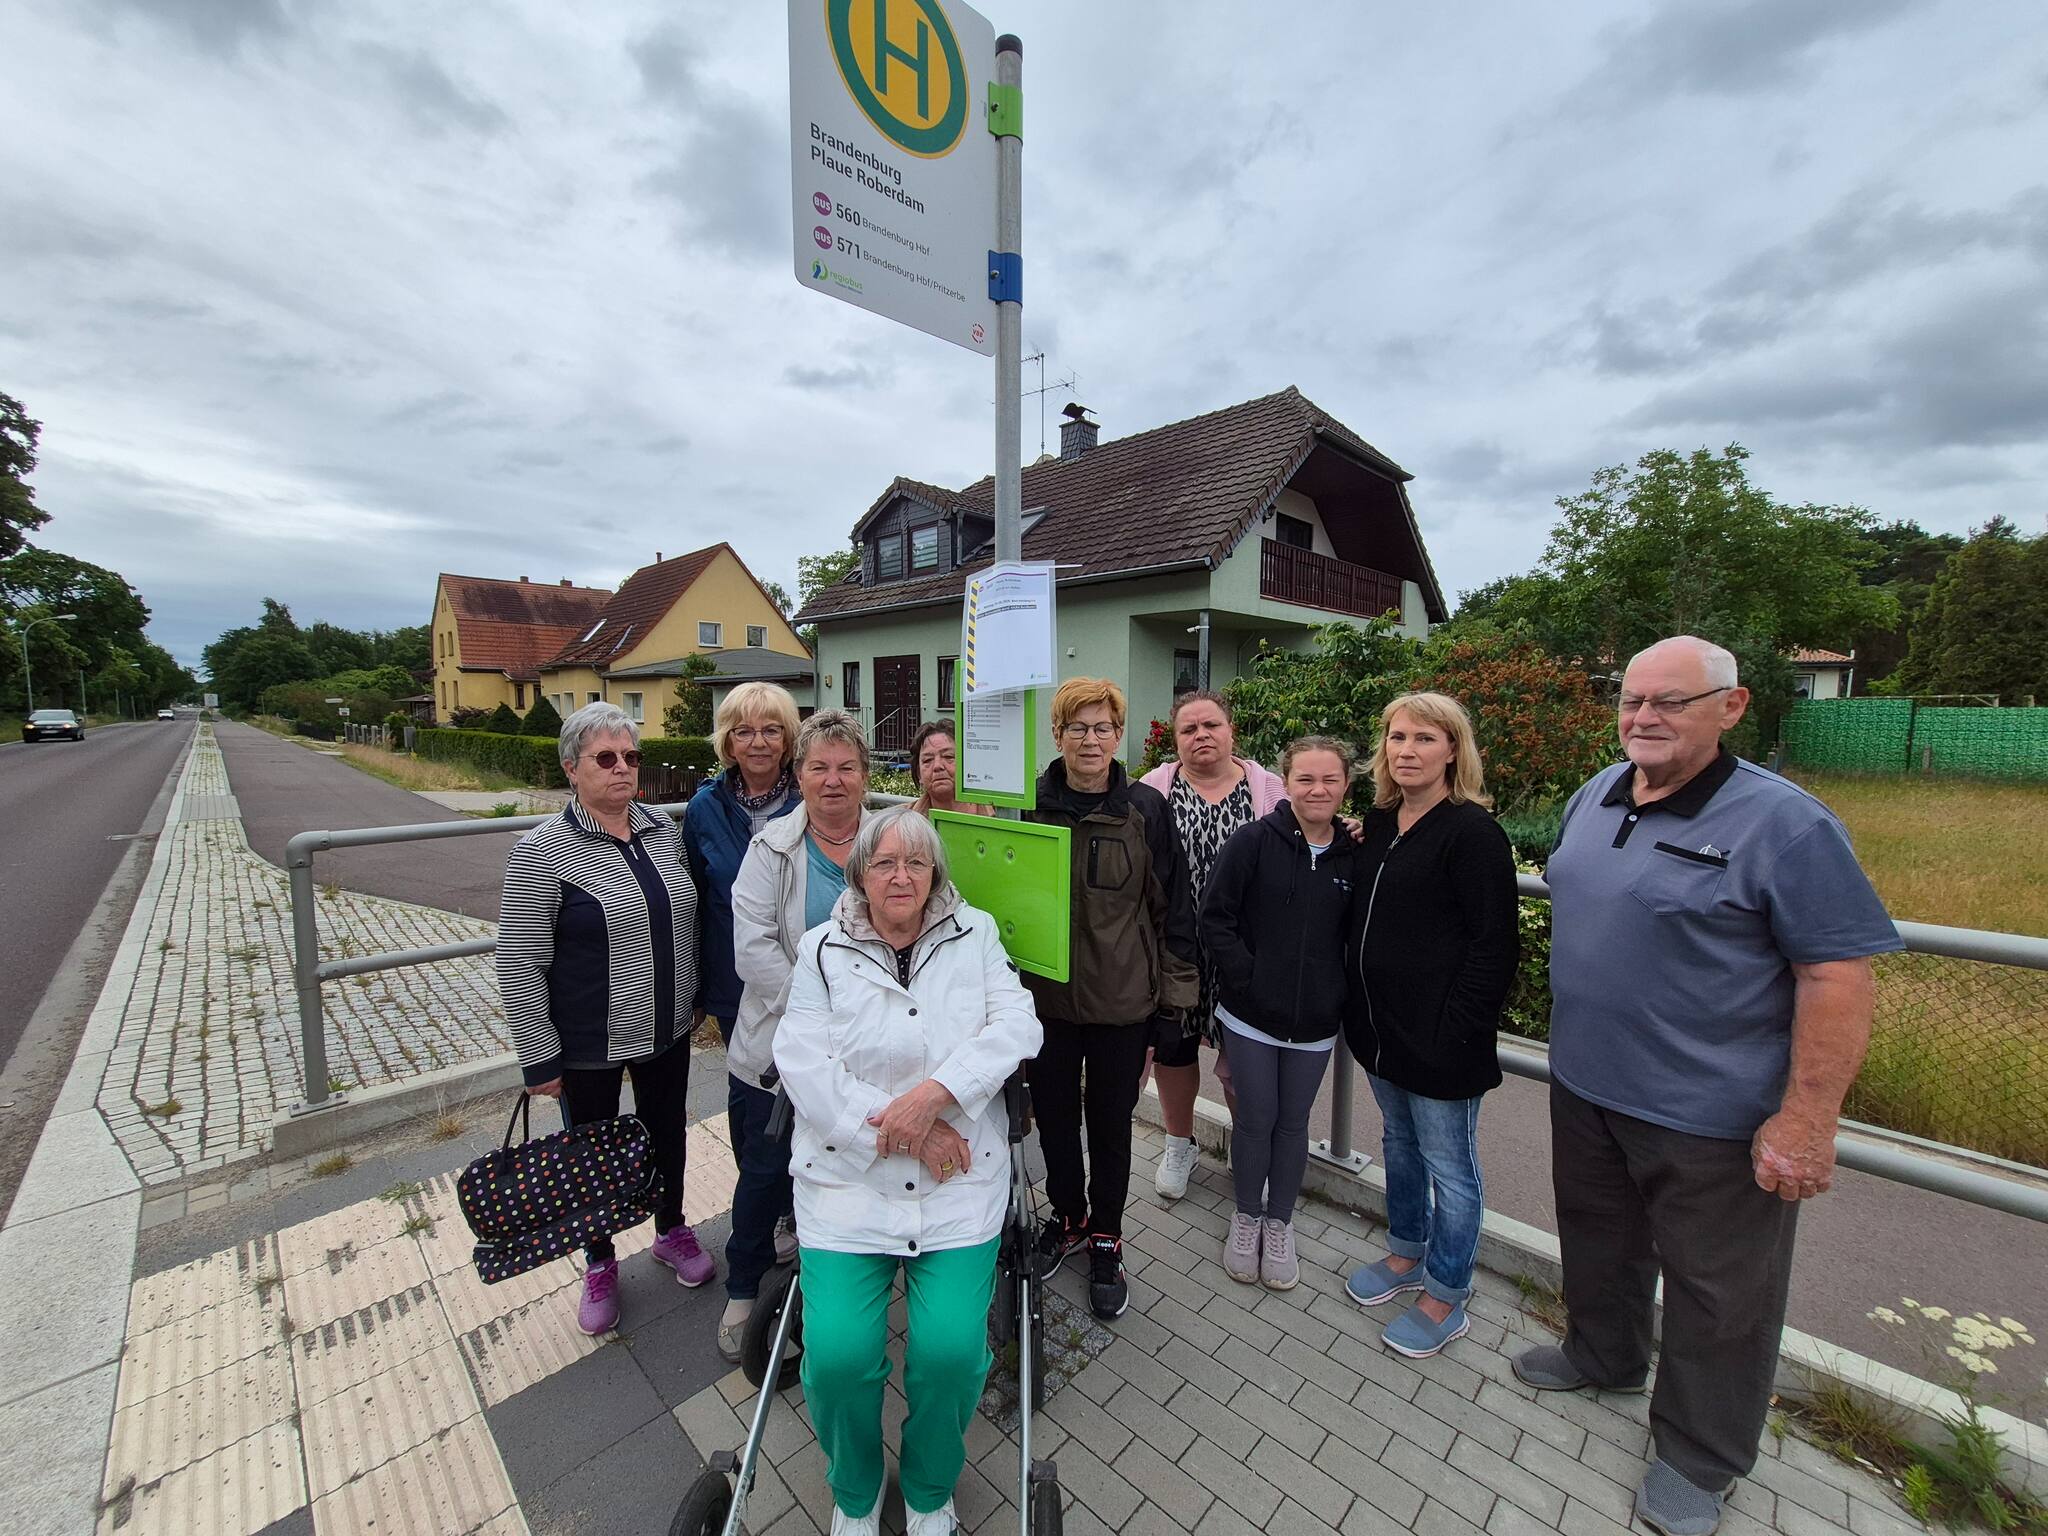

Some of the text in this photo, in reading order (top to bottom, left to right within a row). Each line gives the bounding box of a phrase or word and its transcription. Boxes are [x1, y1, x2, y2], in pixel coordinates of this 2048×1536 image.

[874, 0, 929, 121] H
[810, 122, 902, 185] Brandenburg
[811, 145, 925, 214] Plaue Roberdam
[814, 196, 930, 256] BUS 560 Brandenburg Hbf
[815, 230, 966, 302] BUS 571 Brandenburg Hbf/Pritzerbe
[830, 271, 863, 290] regiobus
